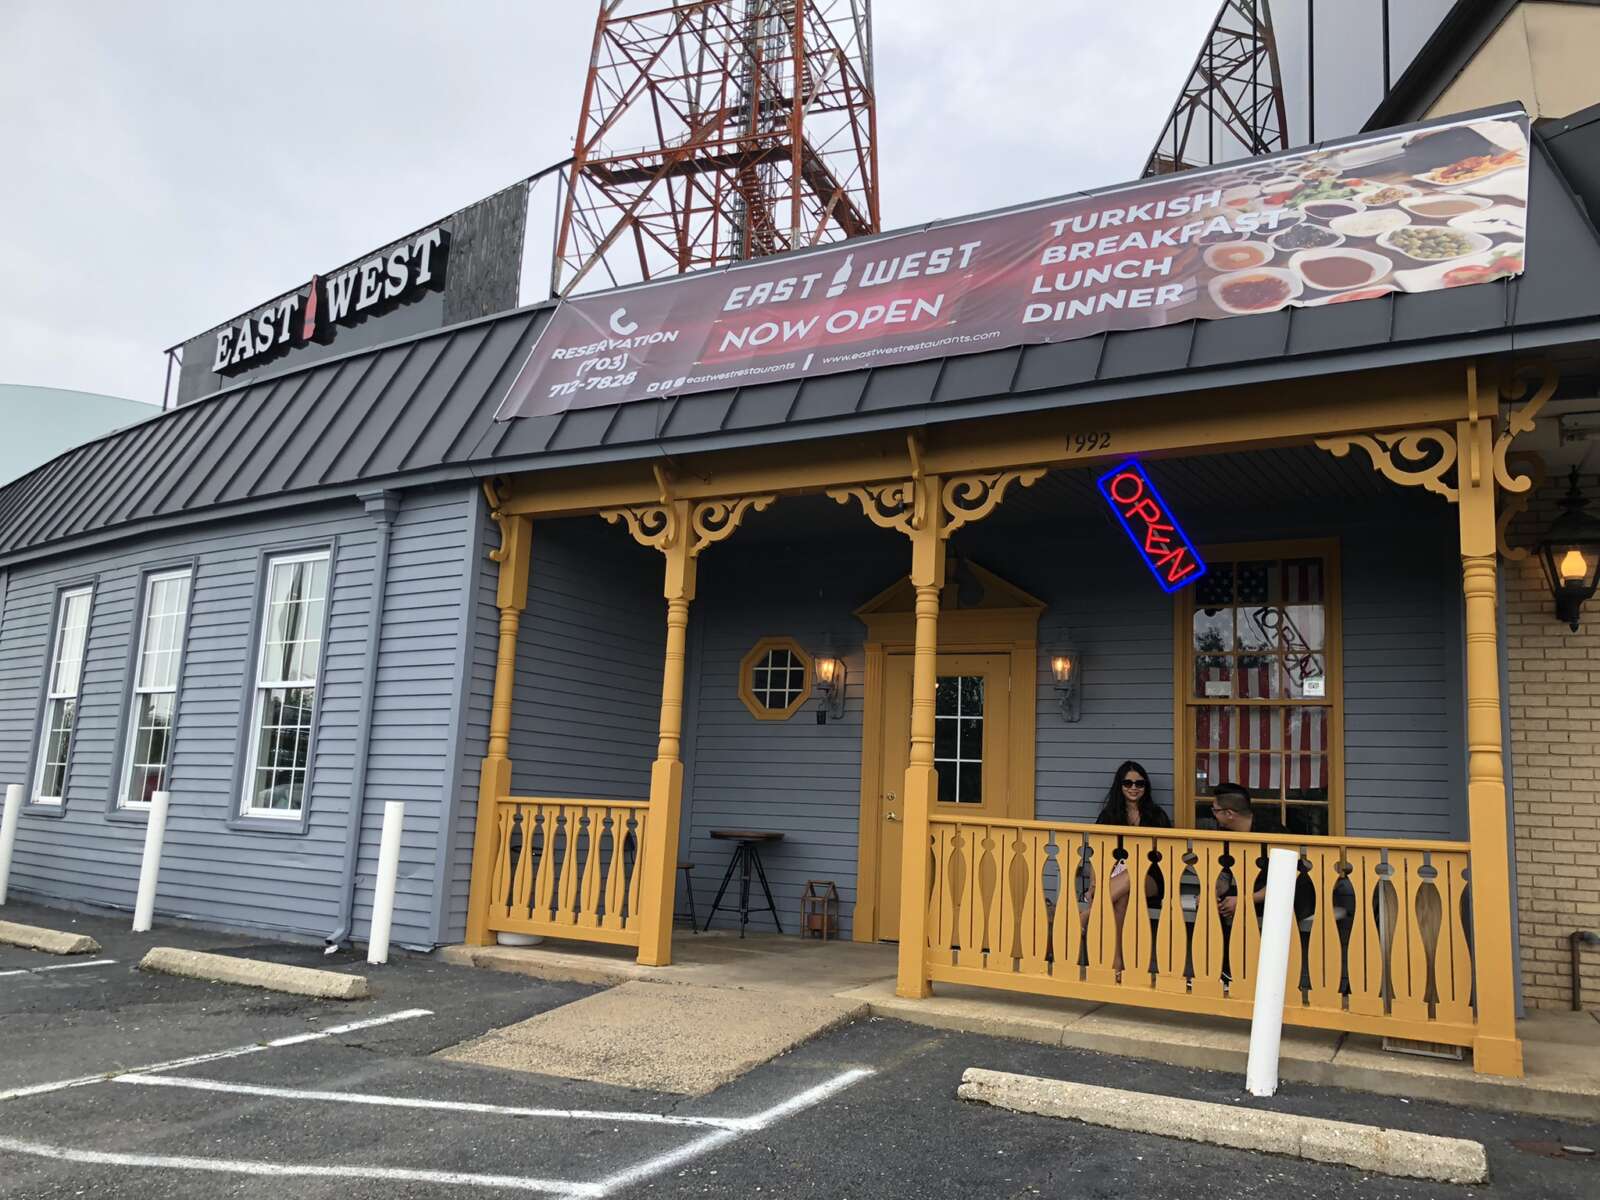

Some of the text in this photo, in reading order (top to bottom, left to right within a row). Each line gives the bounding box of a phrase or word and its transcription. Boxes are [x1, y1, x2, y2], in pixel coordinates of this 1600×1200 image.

[1039, 207, 1289, 266] BREAKFAST
[1050, 189, 1222, 238] TURKISH
[212, 227, 441, 373] EAST WEST
[722, 240, 982, 312] EAST WEST
[1031, 256, 1173, 295] LUNCH
[719, 293, 945, 352] NOW OPEN
[1021, 283, 1185, 325] DINNER
[551, 330, 680, 361] RESERVATION
[576, 353, 629, 377] (703)
[686, 330, 1001, 385] eastwestrestaurants www.eastwestrestaurants.com
[548, 371, 638, 399] 712-7828
[1065, 431, 1112, 454] 1992
[1110, 472, 1196, 583] OPEN
